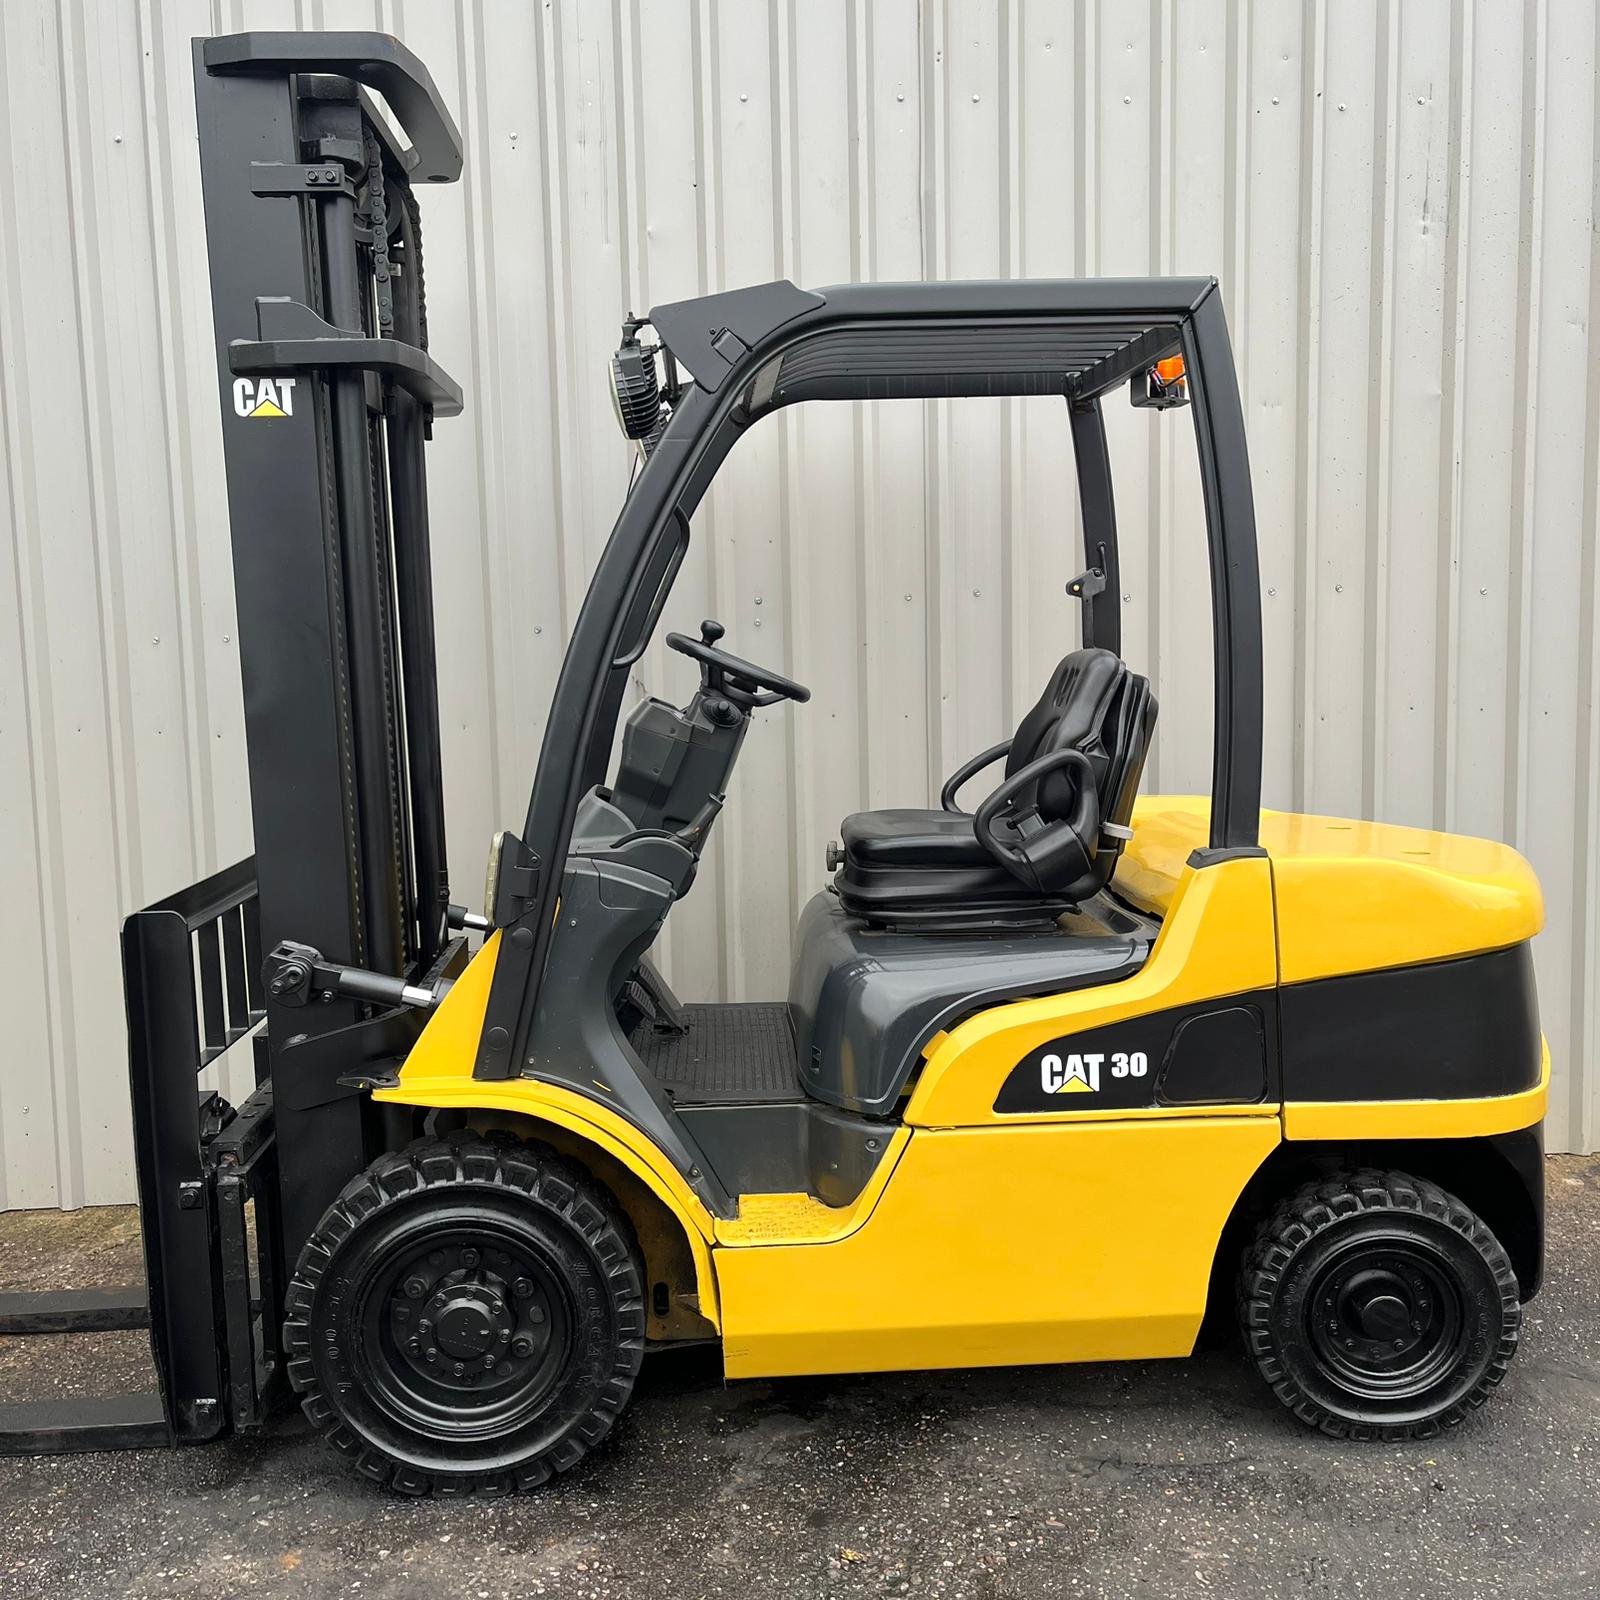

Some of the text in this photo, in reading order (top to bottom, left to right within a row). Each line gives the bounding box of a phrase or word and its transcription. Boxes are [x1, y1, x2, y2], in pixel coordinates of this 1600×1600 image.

[233, 377, 296, 417] CAT
[1041, 1052, 1148, 1094] CAT 30
